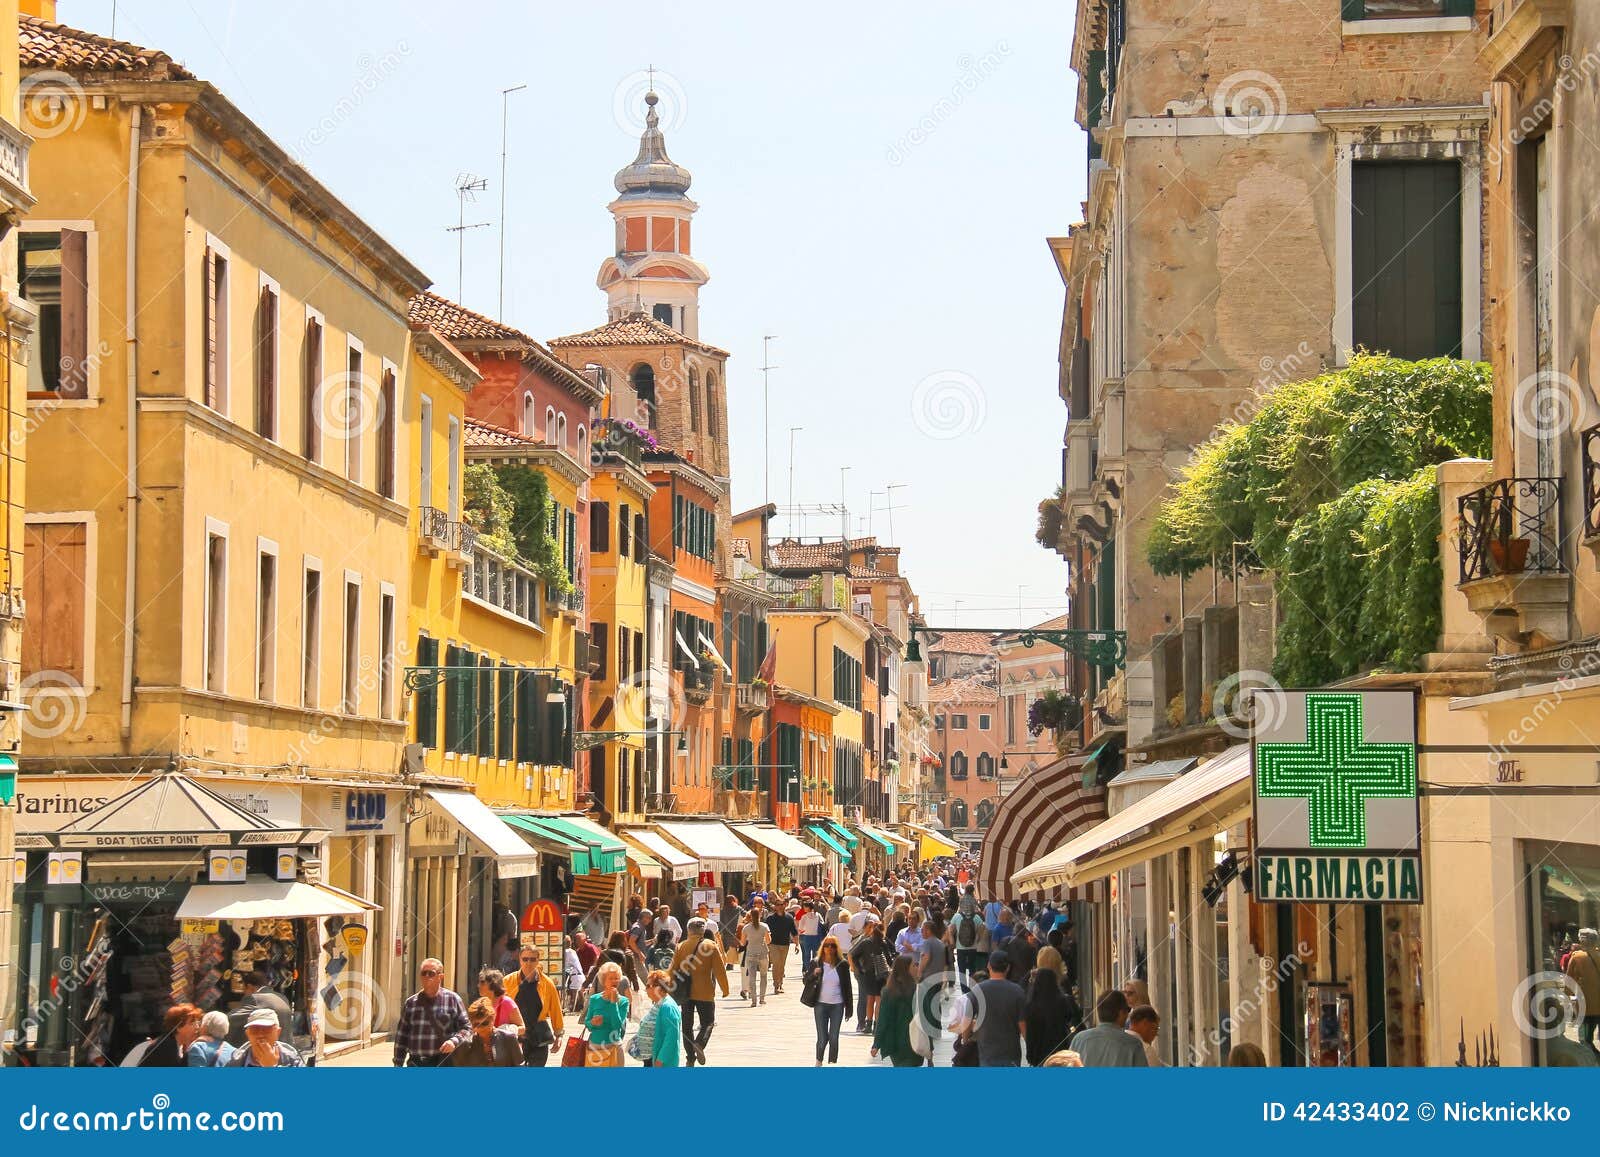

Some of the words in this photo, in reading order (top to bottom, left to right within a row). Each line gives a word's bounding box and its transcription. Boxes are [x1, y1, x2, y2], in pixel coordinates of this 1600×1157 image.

[96, 837, 126, 845] BOAT
[130, 836, 164, 845] TICKET
[170, 835, 199, 844] POINT
[1260, 857, 1419, 900] FARMACIA
